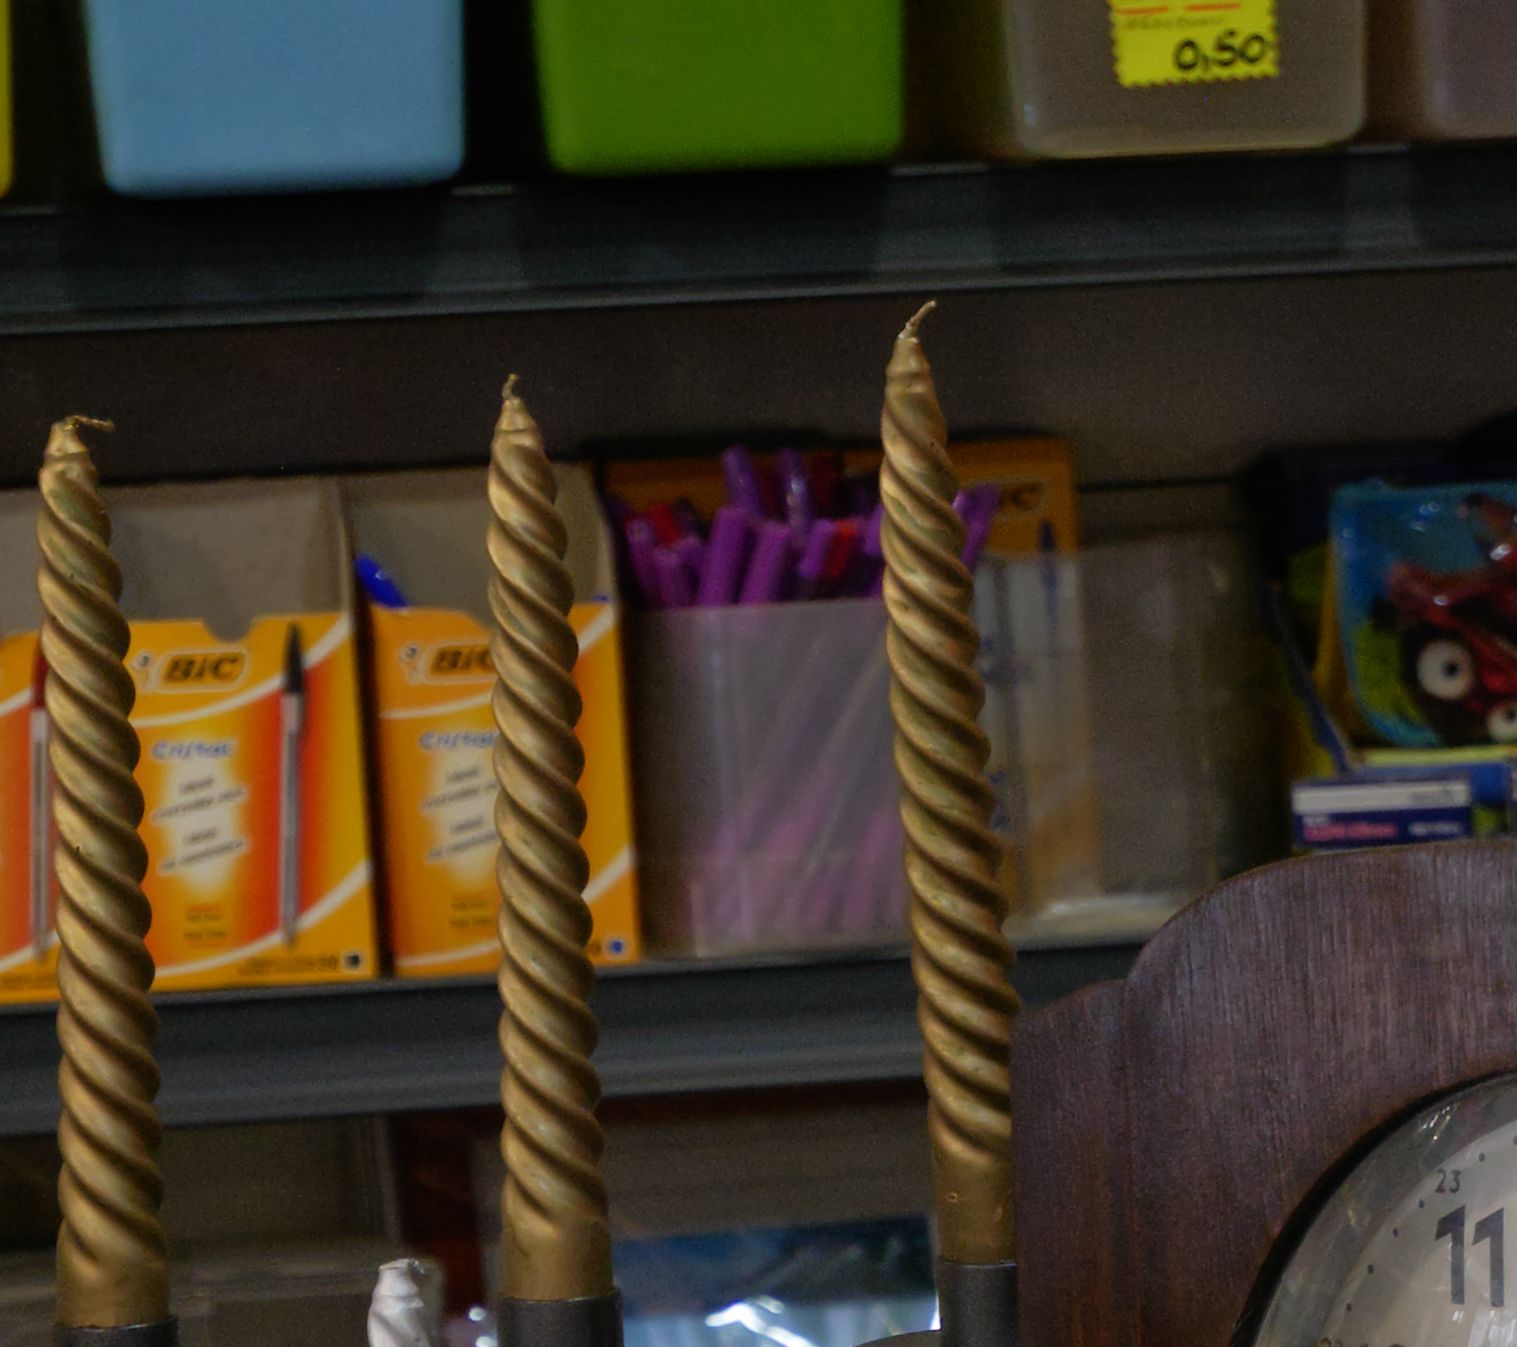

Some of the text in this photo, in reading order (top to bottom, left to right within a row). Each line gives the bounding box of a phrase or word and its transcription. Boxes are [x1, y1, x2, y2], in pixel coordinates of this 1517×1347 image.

[1172, 28, 1266, 71] 0,50
[163, 655, 240, 682] BIC
[1434, 1169, 1462, 1194] 23
[1435, 1205, 1505, 1307] 11
